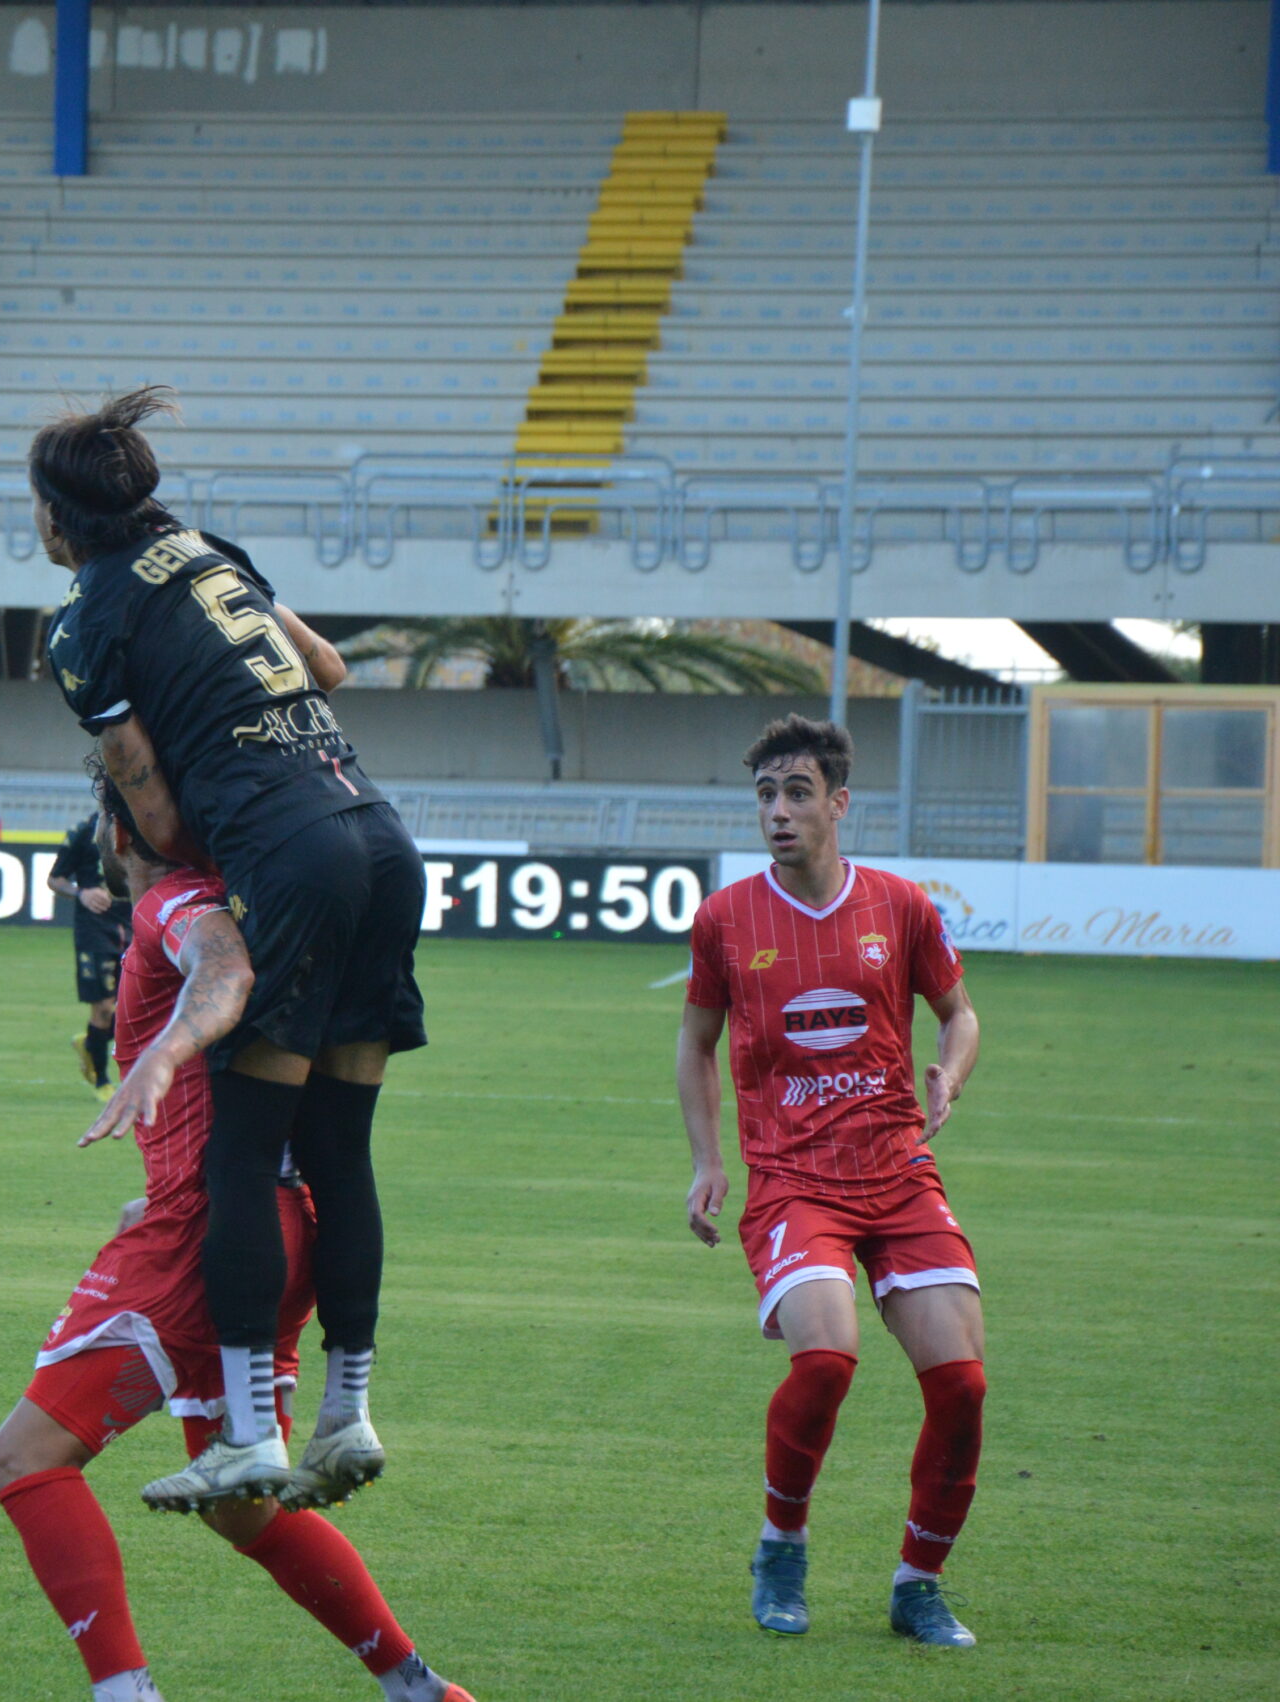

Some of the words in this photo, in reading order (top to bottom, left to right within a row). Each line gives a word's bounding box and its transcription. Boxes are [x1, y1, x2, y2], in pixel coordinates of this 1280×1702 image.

[190, 564, 309, 696] 5
[1084, 907, 1238, 947] Maria
[785, 1007, 867, 1031] RAYS
